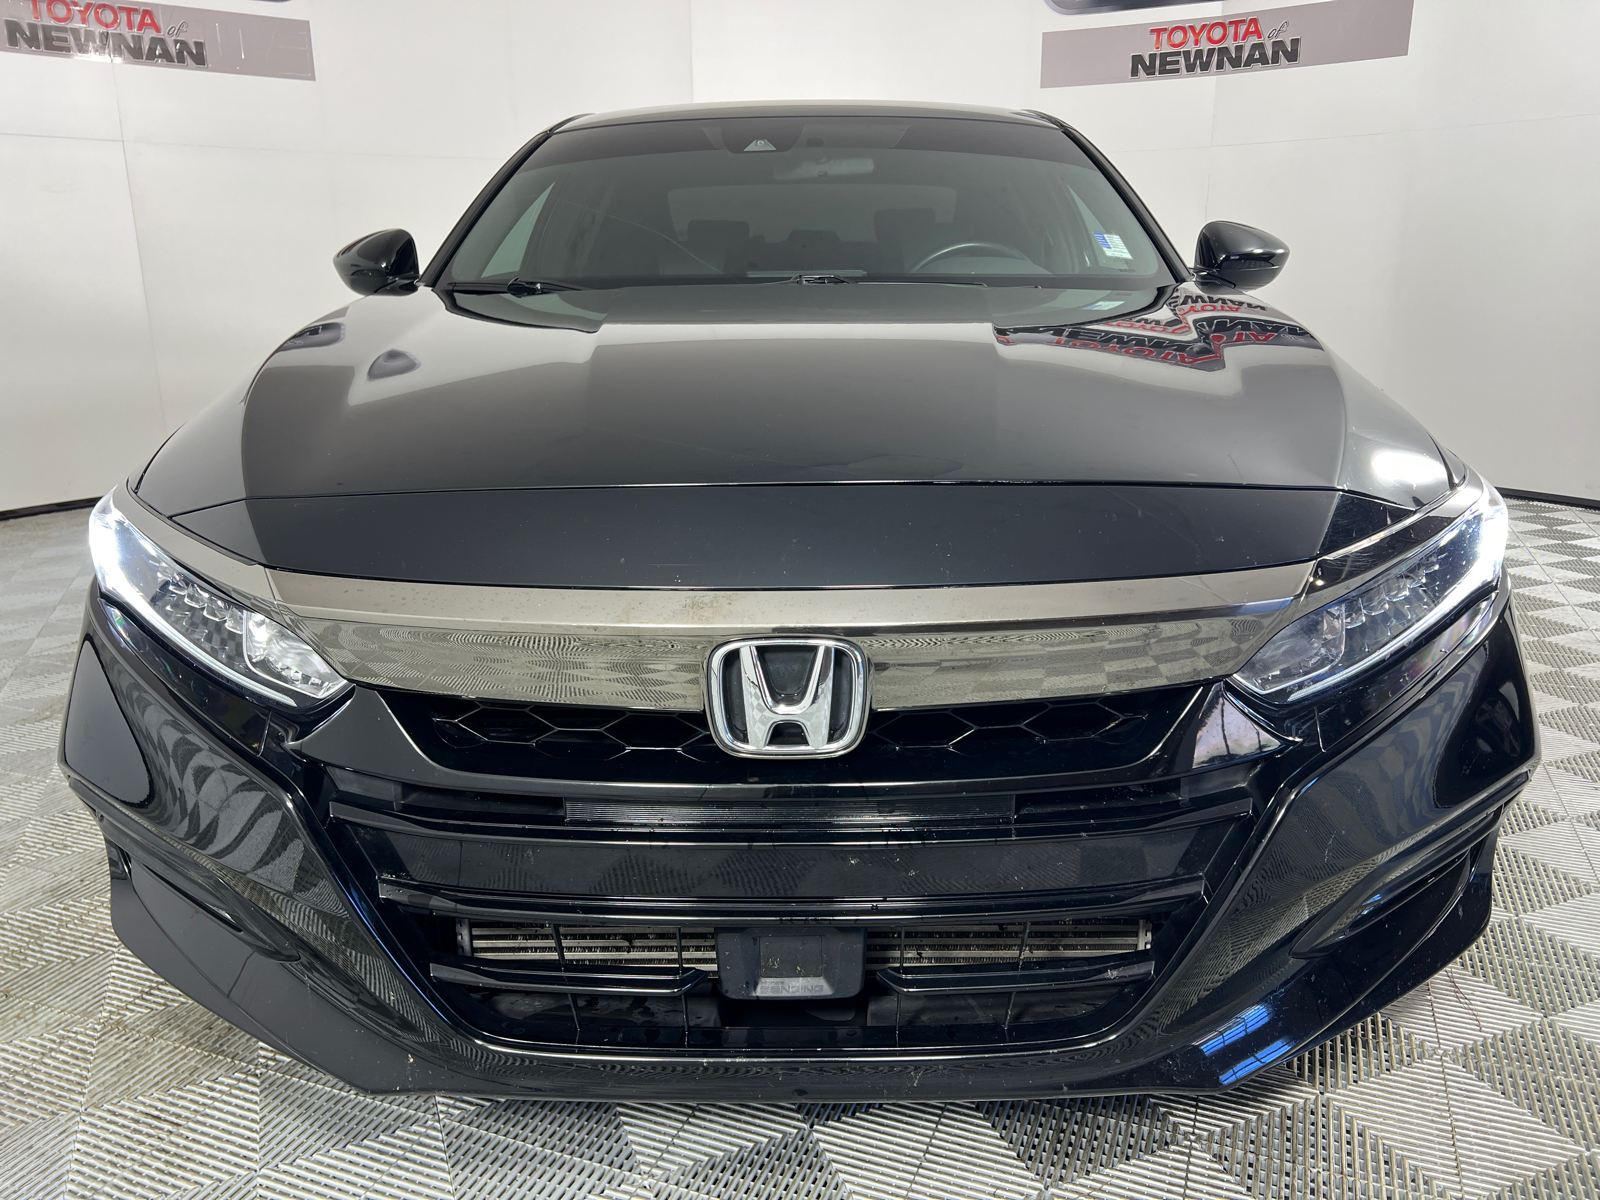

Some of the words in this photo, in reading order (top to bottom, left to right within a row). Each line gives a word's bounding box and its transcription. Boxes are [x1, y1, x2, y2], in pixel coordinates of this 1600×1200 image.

[29, 0, 162, 34] TOYOTA
[167, 21, 188, 37] of
[1150, 17, 1263, 49] TOYOTA
[1267, 21, 1289, 40] of
[4, 19, 206, 66] NEWNAN
[1130, 38, 1300, 78] NEWNAN
